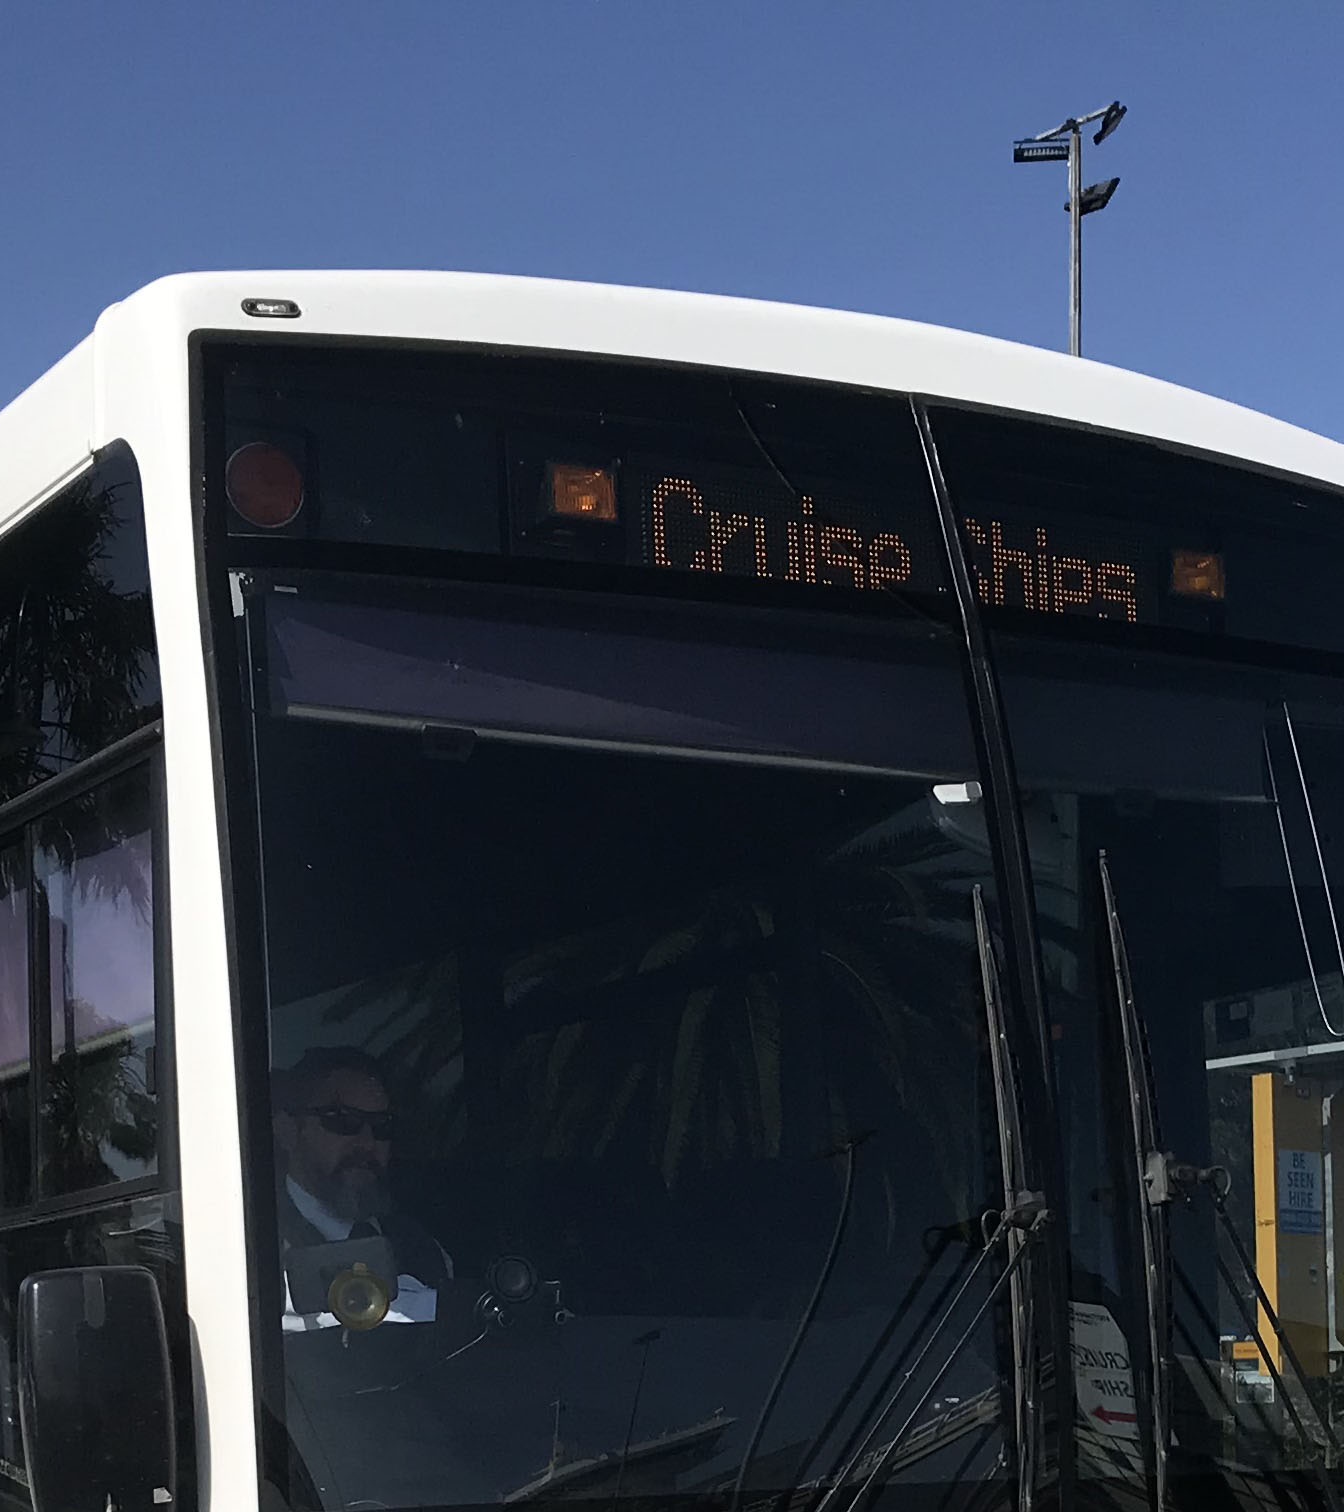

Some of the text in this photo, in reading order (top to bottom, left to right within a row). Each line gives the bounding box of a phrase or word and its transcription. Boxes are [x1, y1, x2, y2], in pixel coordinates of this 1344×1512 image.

[653, 475, 912, 591] Cruise
[1292, 1152, 1306, 1170] BE
[1287, 1171, 1314, 1189] SEEN
